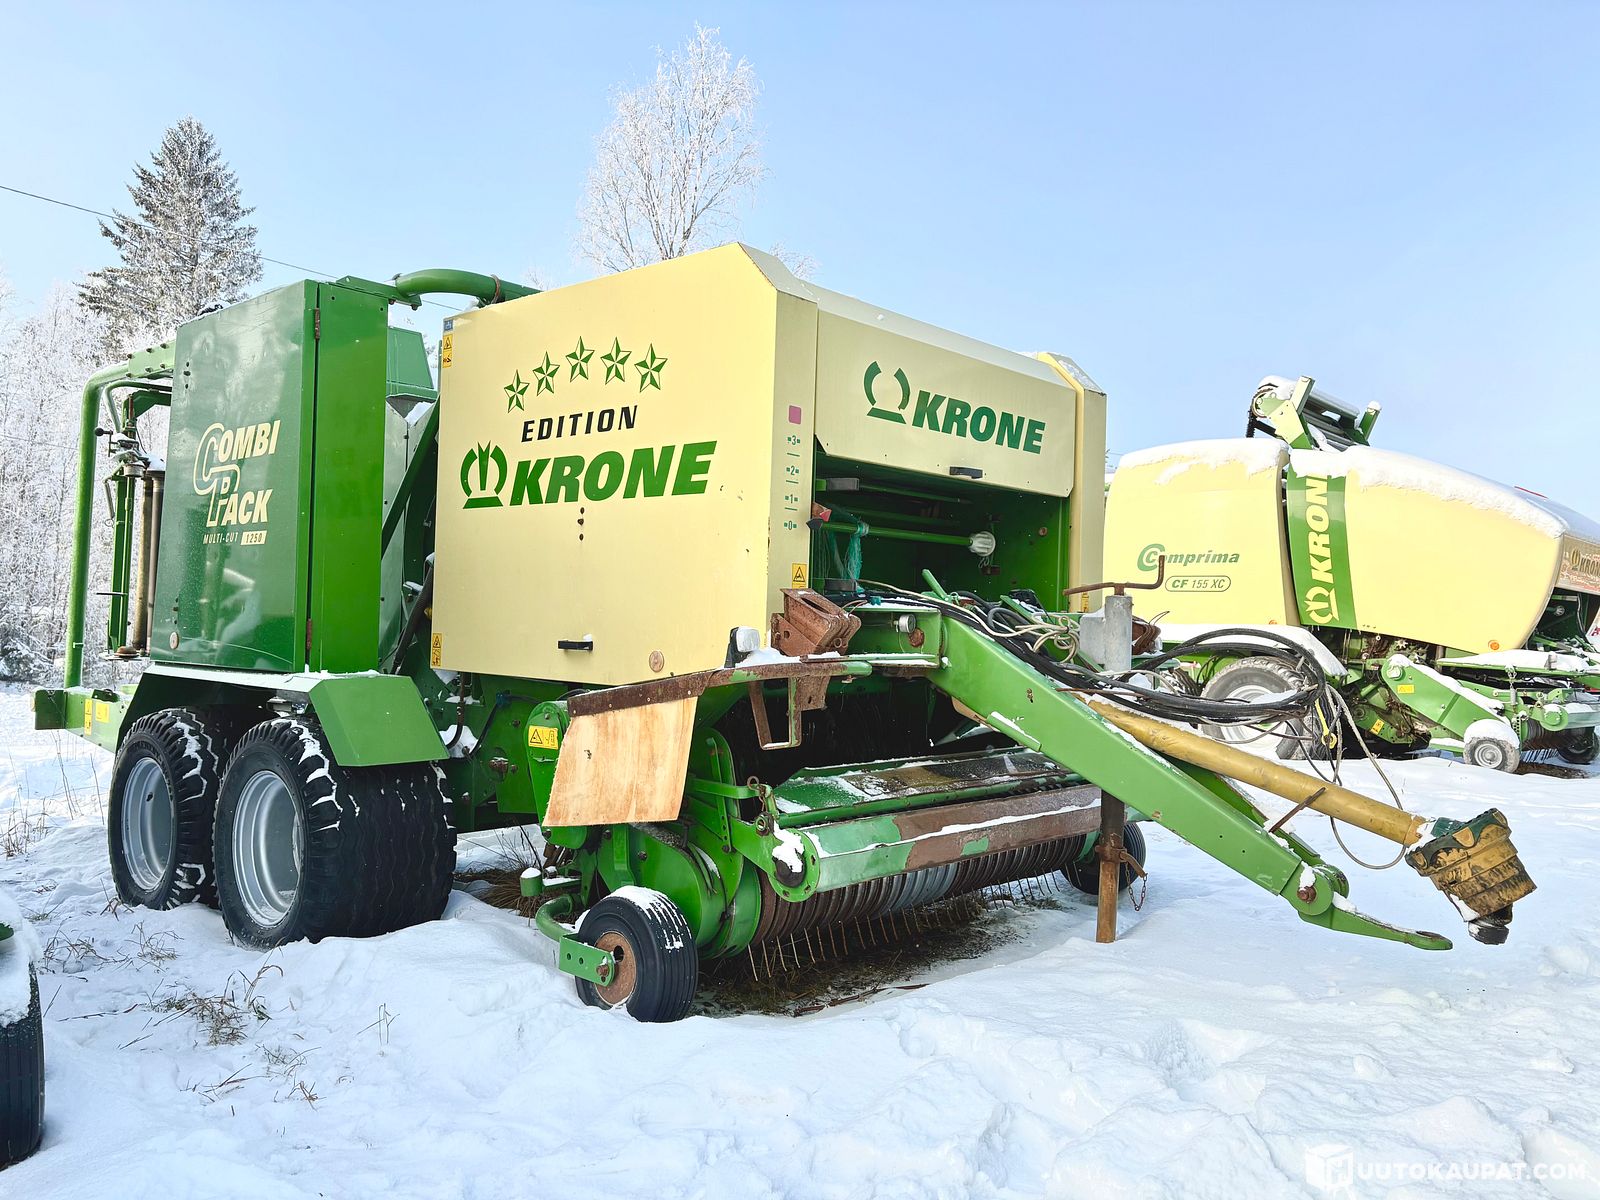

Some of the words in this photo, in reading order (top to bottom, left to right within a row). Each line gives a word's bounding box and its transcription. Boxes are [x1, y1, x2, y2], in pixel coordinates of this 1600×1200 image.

[521, 405, 638, 442] EDITION
[912, 390, 1046, 455] KRONE
[193, 420, 280, 495] COMBI
[509, 440, 718, 506] KRONE
[206, 464, 273, 527] PACK
[1137, 543, 1240, 572] Cmprima
[1305, 474, 1334, 584] KRON
[1171, 579, 1188, 589] CF
[1191, 579, 1209, 589] 155
[1210, 578, 1226, 589] XC
